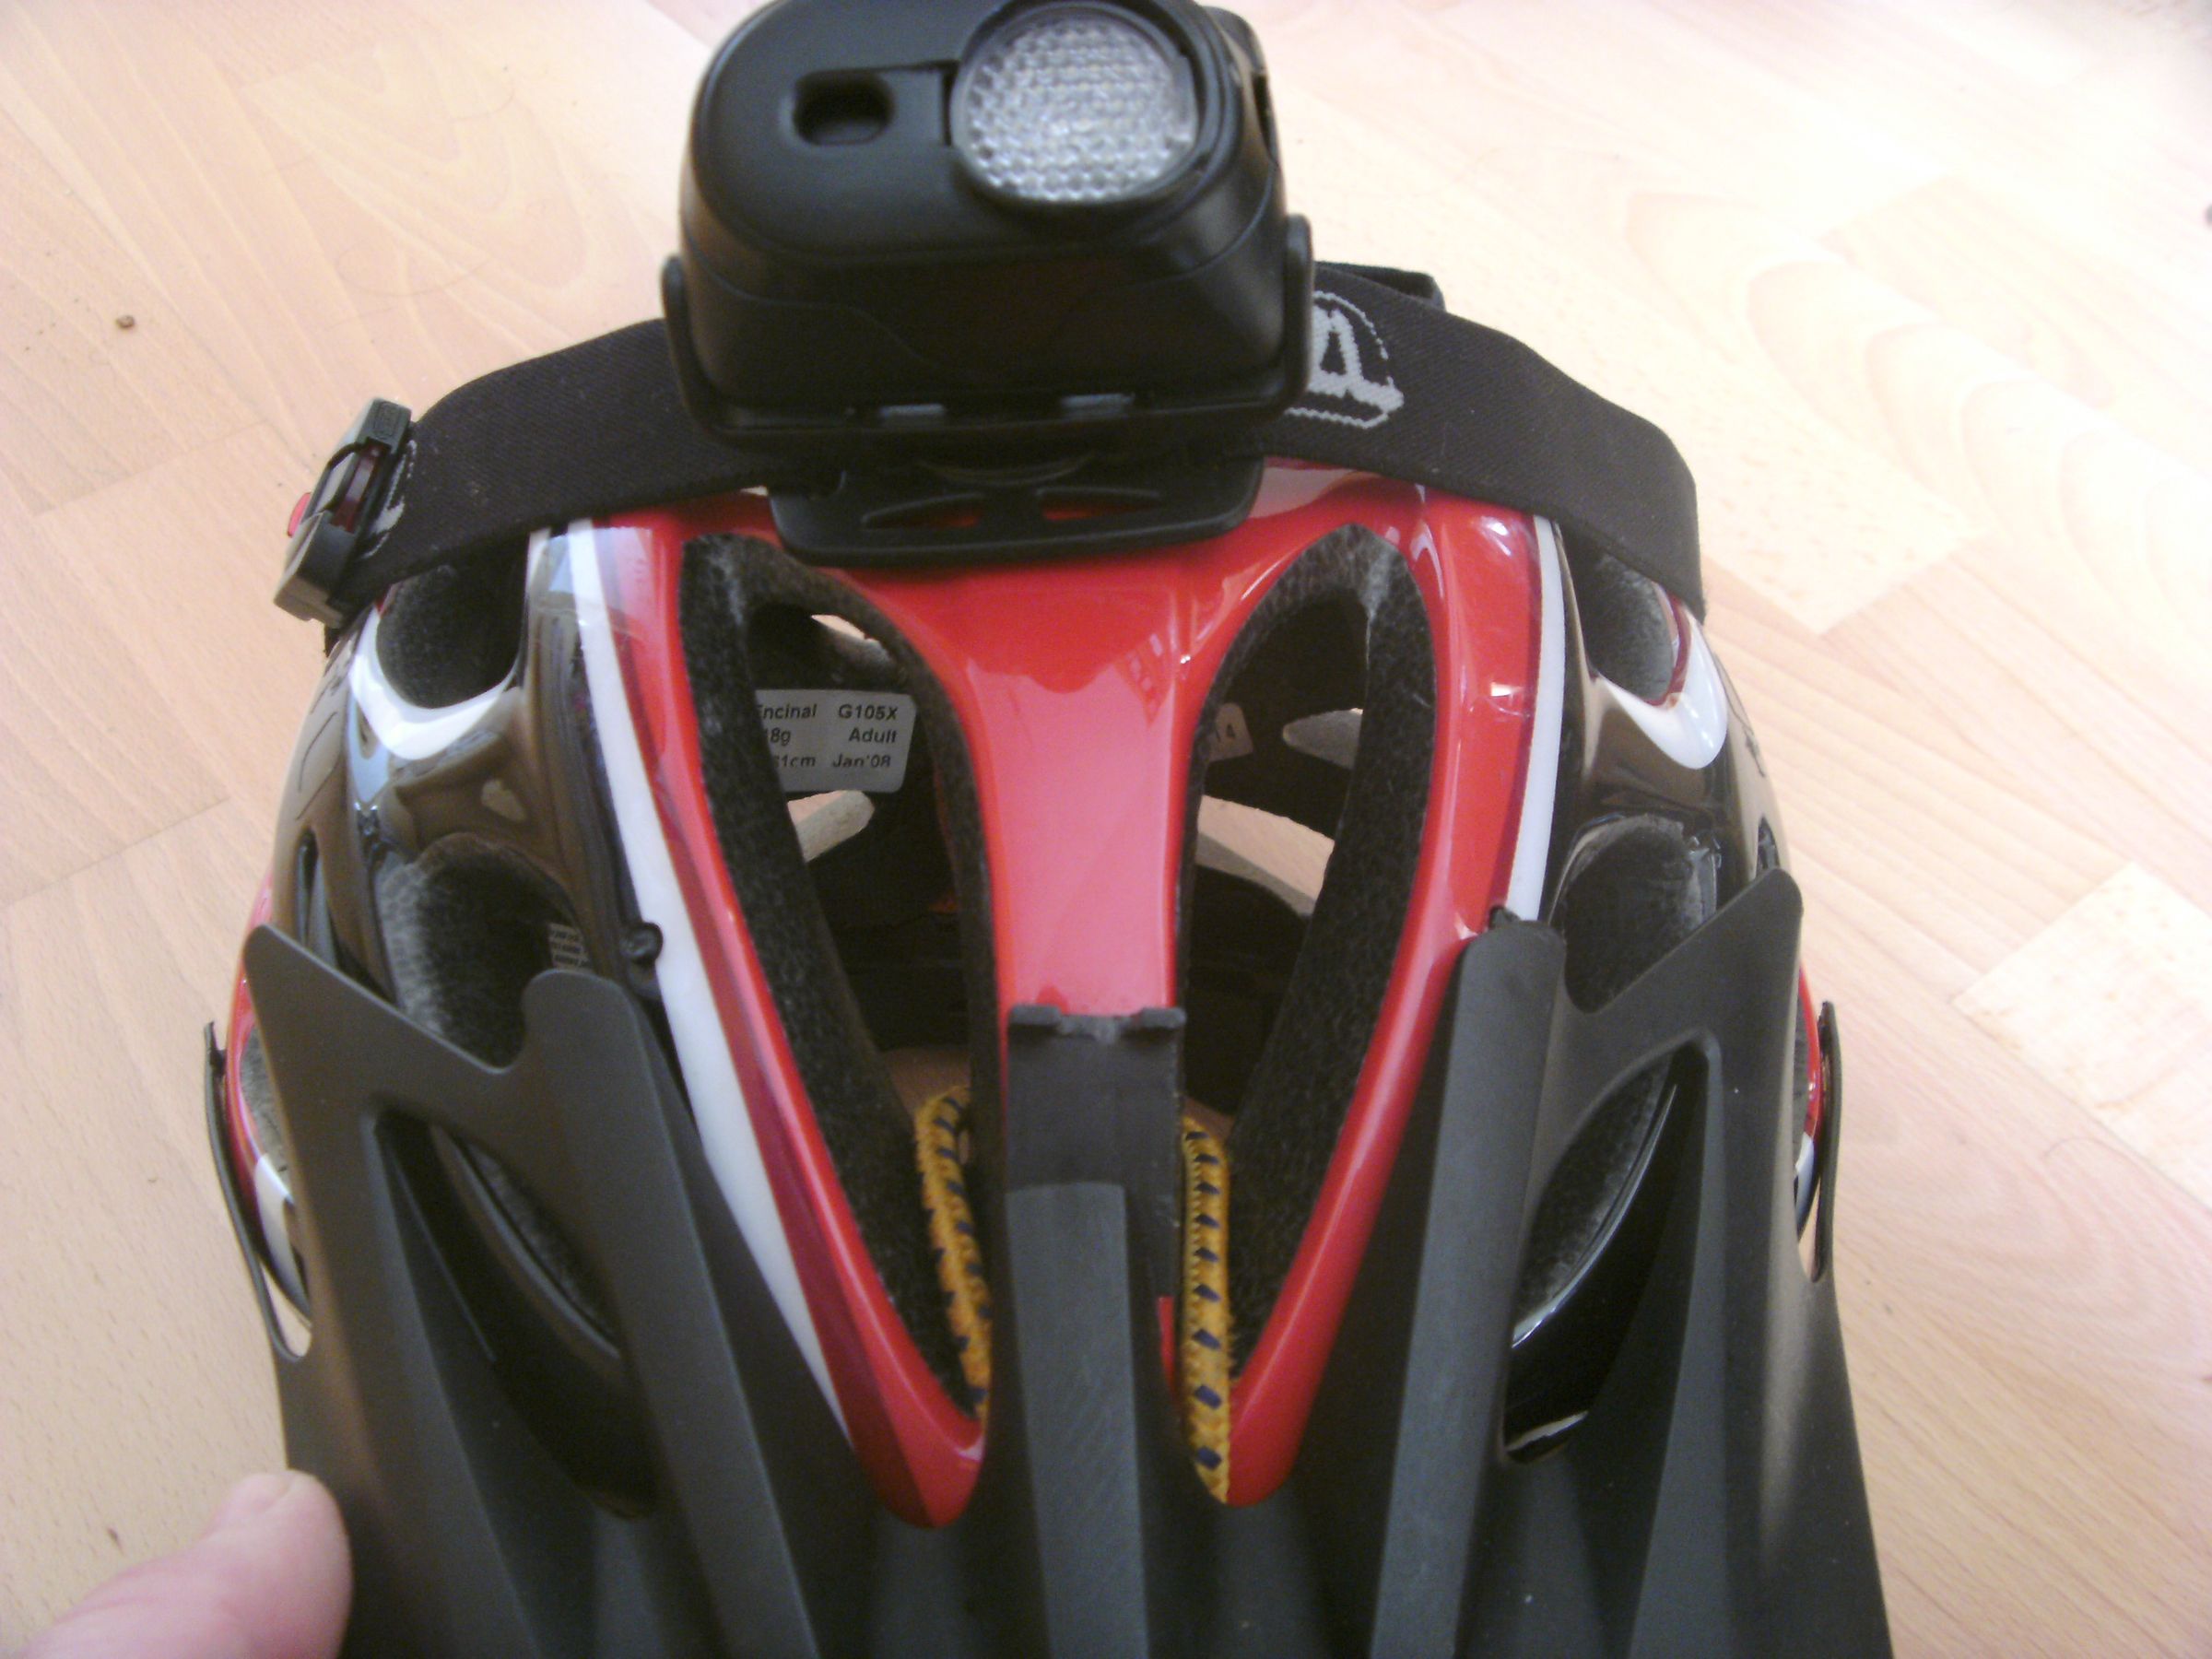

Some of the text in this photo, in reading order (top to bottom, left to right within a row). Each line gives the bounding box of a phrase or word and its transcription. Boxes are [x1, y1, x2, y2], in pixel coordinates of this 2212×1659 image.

[839, 704, 898, 721] G105X
[765, 727, 898, 746] 8g Adult
[832, 753, 891, 768] Jan'08
